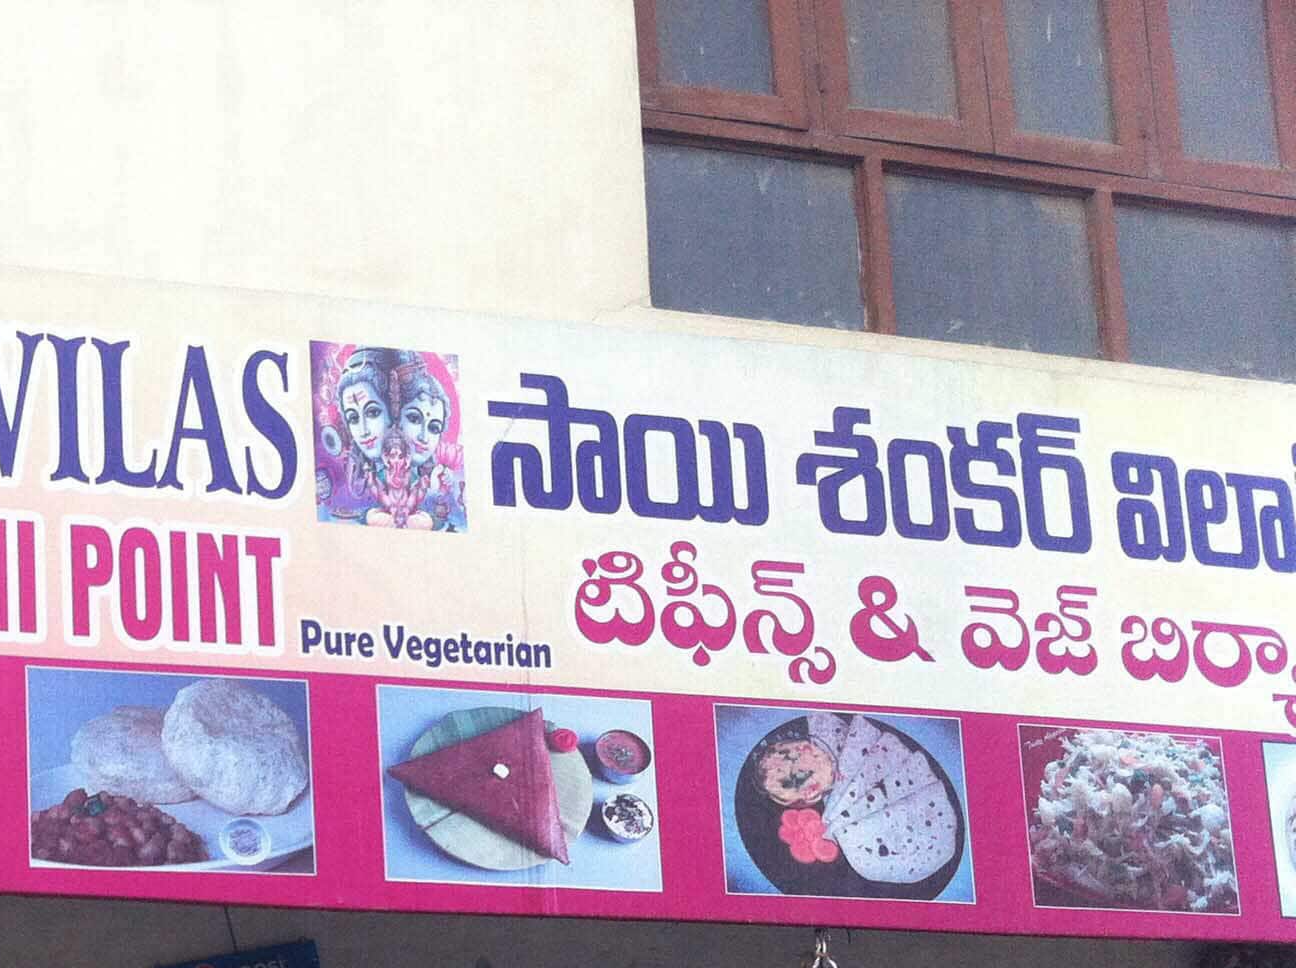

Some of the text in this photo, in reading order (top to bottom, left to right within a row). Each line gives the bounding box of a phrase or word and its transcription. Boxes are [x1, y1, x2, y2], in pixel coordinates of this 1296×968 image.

[487, 372, 1296, 575] సాయి శంకర్ విలా
[71, 525, 283, 649] POINT
[849, 574, 936, 663] &
[960, 584, 1099, 677] వెజ్
[301, 620, 553, 669] Pure Vegetarian
